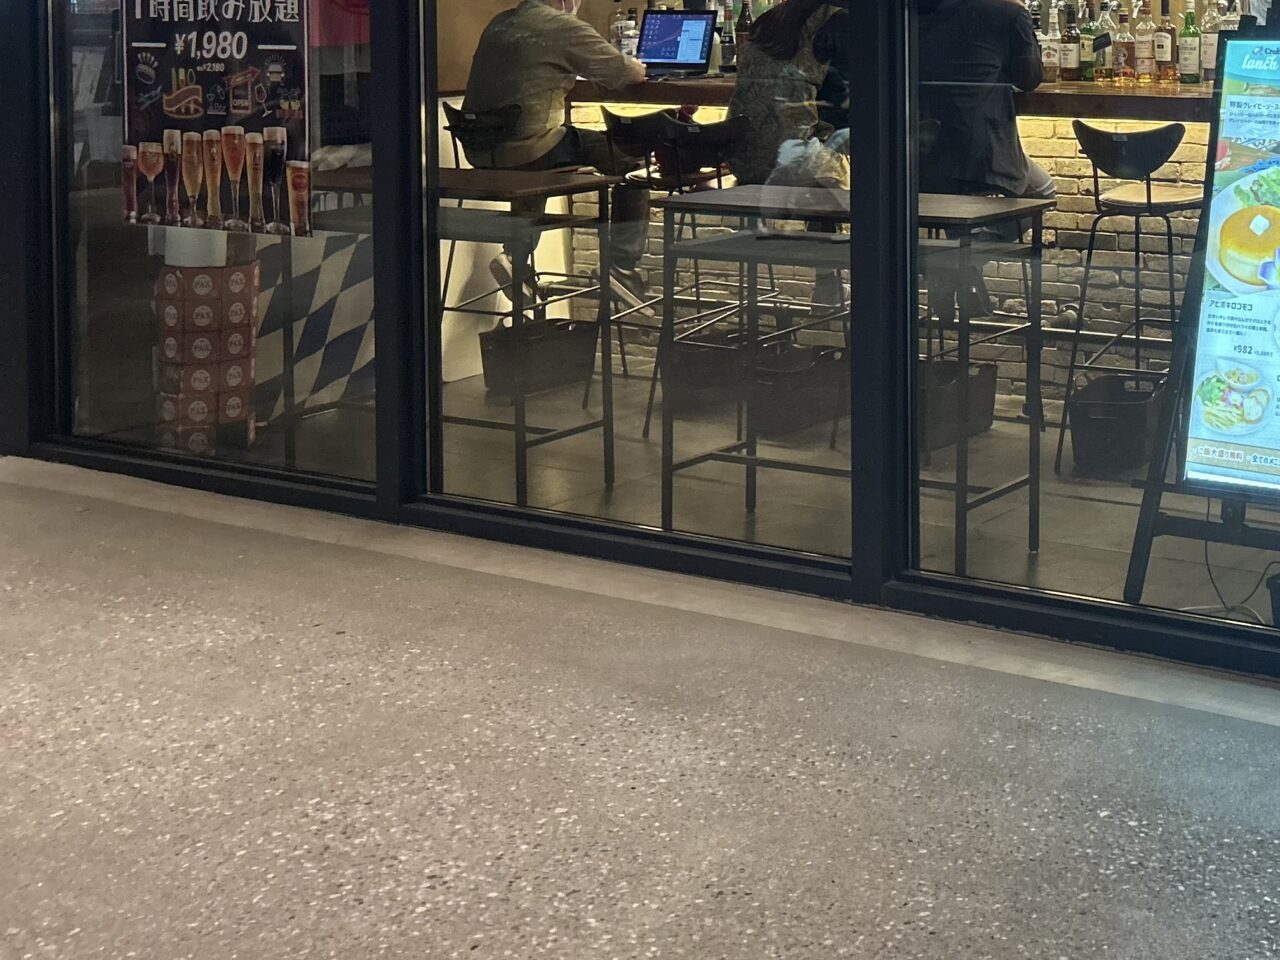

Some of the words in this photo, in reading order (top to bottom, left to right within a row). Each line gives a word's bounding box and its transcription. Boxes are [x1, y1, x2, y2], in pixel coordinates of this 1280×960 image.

[175, 30, 249, 60] ¥1,980
[1242, 53, 1279, 70] lunch
[1234, 344, 1252, 355] ¥982
